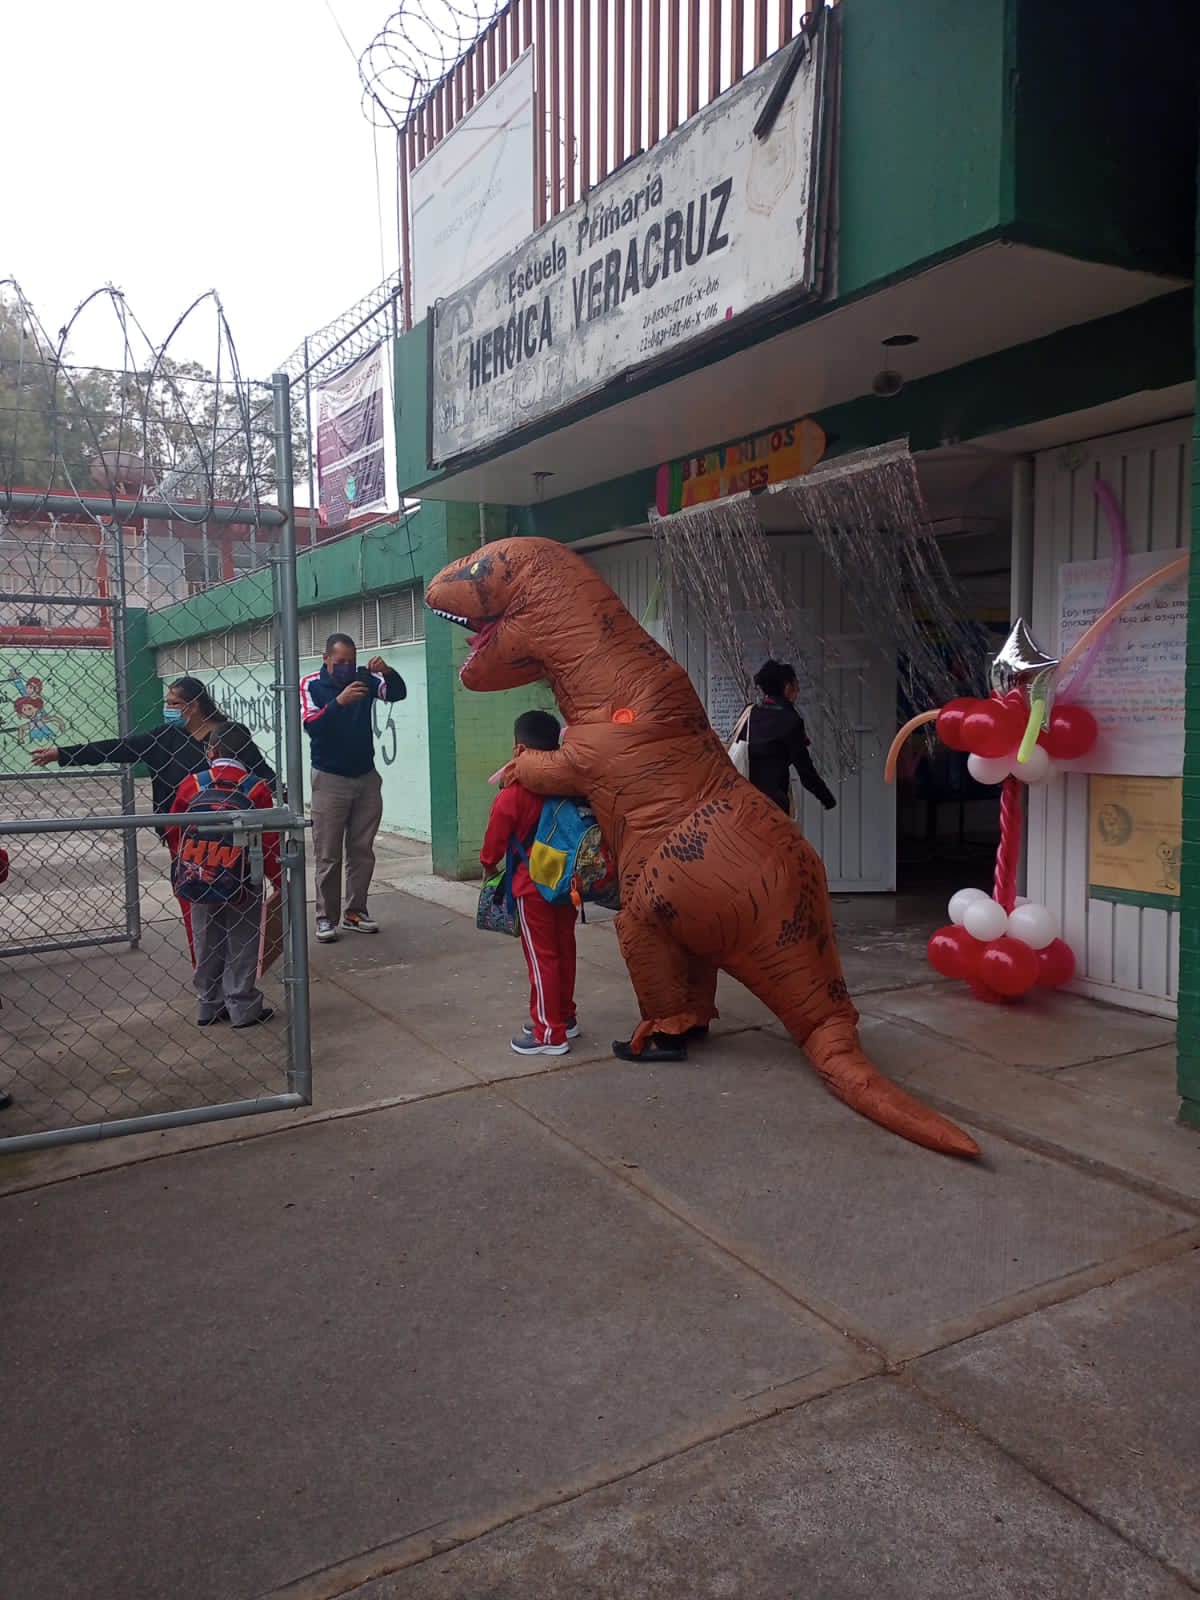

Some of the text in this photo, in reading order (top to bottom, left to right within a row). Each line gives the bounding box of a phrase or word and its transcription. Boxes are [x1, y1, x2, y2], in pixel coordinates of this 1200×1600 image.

[508, 241, 567, 302] Escuela
[577, 174, 664, 256] Primaria
[572, 176, 732, 331] VERACRUZ
[181, 838, 242, 868] HW
